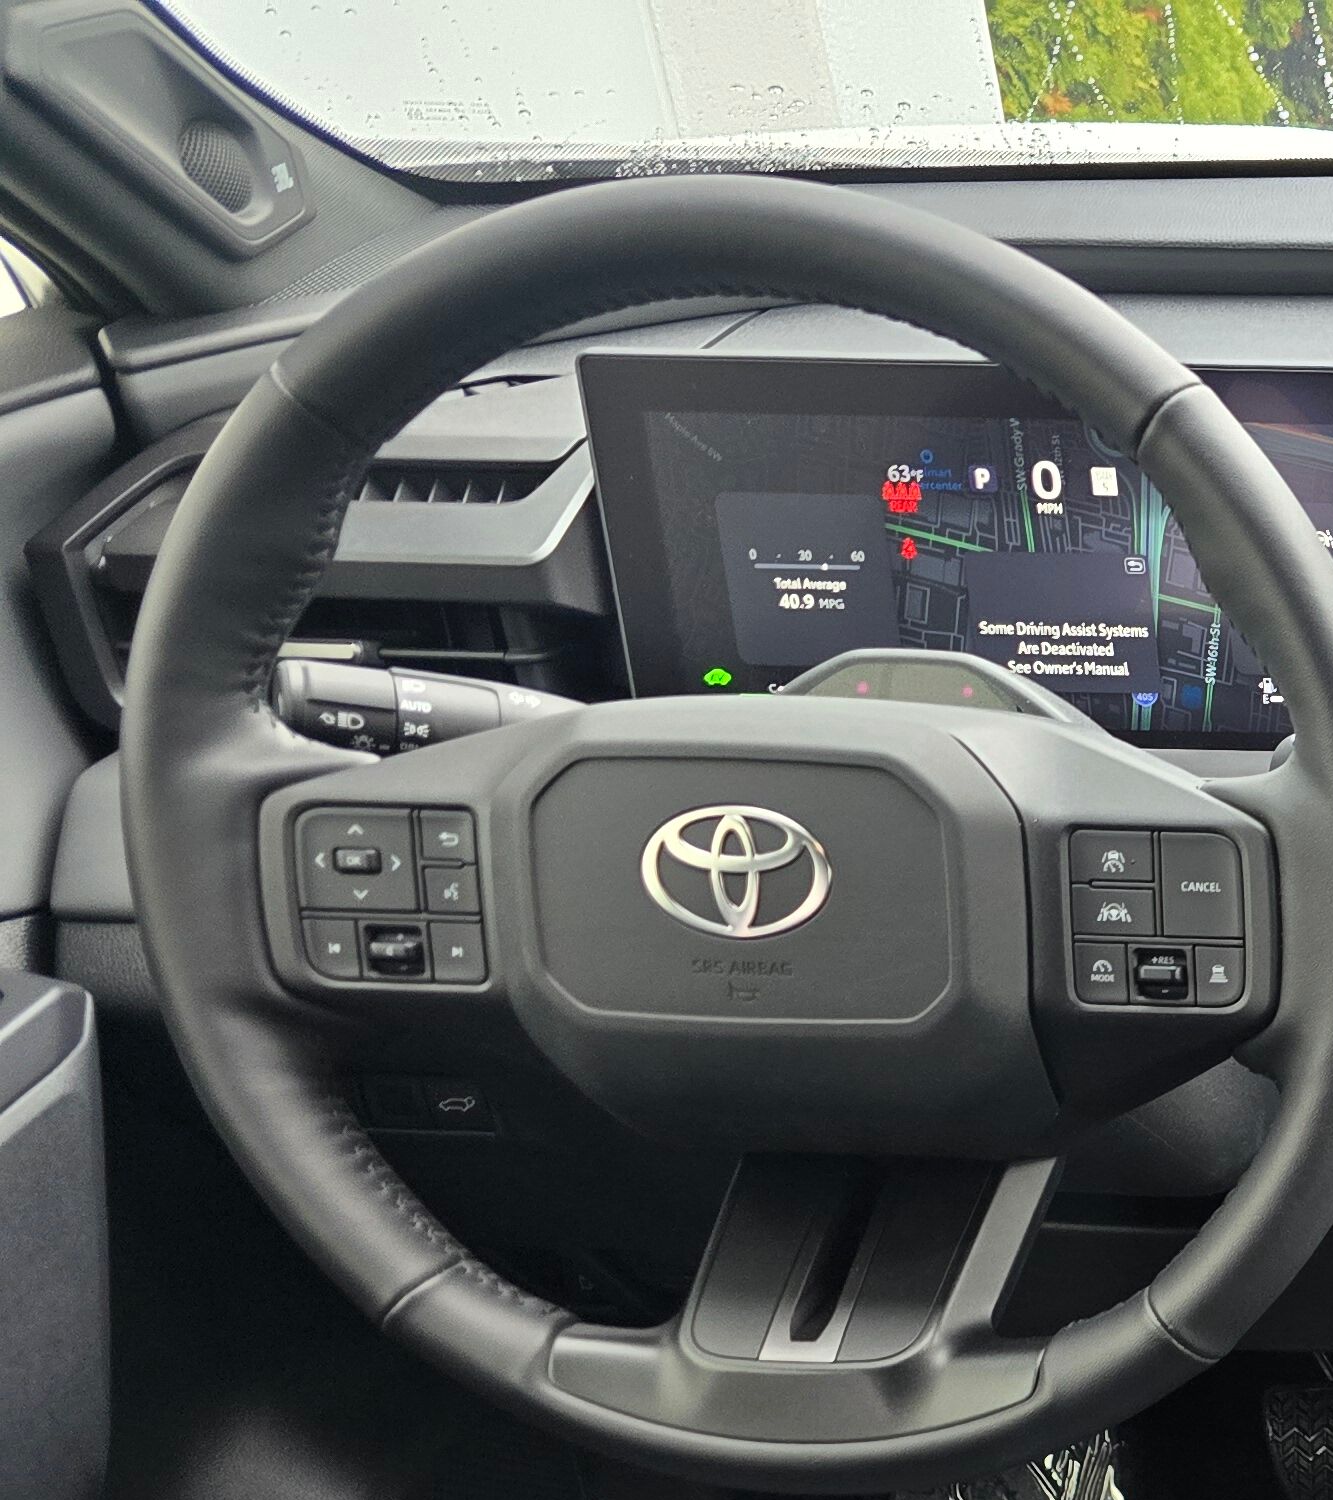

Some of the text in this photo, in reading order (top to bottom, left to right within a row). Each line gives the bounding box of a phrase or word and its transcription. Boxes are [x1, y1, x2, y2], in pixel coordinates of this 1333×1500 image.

[974, 467, 990, 490] P
[1032, 460, 1062, 500] 0
[1037, 502, 1063, 515] MPH
[749, 548, 865, 562] 0 30 60
[774, 577, 847, 593] Total Average
[778, 593, 815, 609] 40.9
[978, 621, 1149, 640] Some Driving Assist Systems
[1018, 641, 1115, 657] Are Deactivated
[1007, 660, 1130, 677] See Owner's Manual
[401, 700, 432, 713] AUTO
[1181, 881, 1221, 893] CANCEL
[729, 960, 793, 976] AIRBAG
[1091, 973, 1115, 983] MODE
